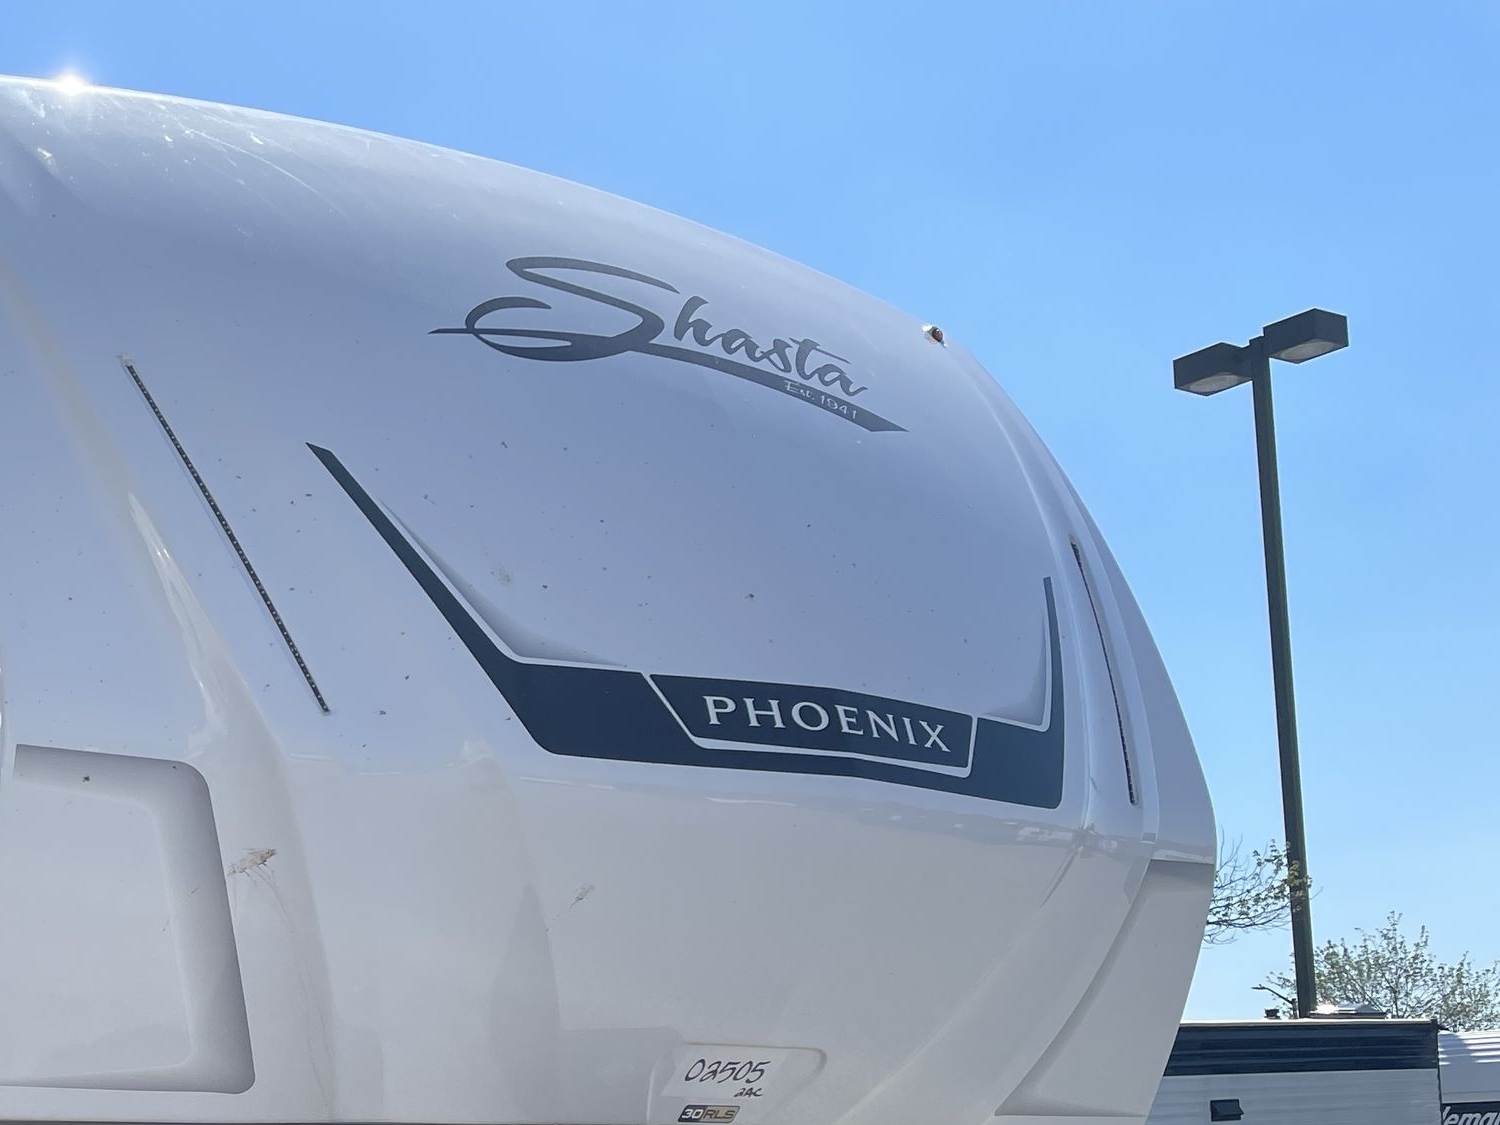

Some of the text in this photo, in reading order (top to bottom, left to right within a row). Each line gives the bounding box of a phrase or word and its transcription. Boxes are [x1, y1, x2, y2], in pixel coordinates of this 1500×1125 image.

[428, 256, 872, 400] Shasta
[820, 394, 858, 420] 1941
[702, 694, 952, 753] PHOENIX
